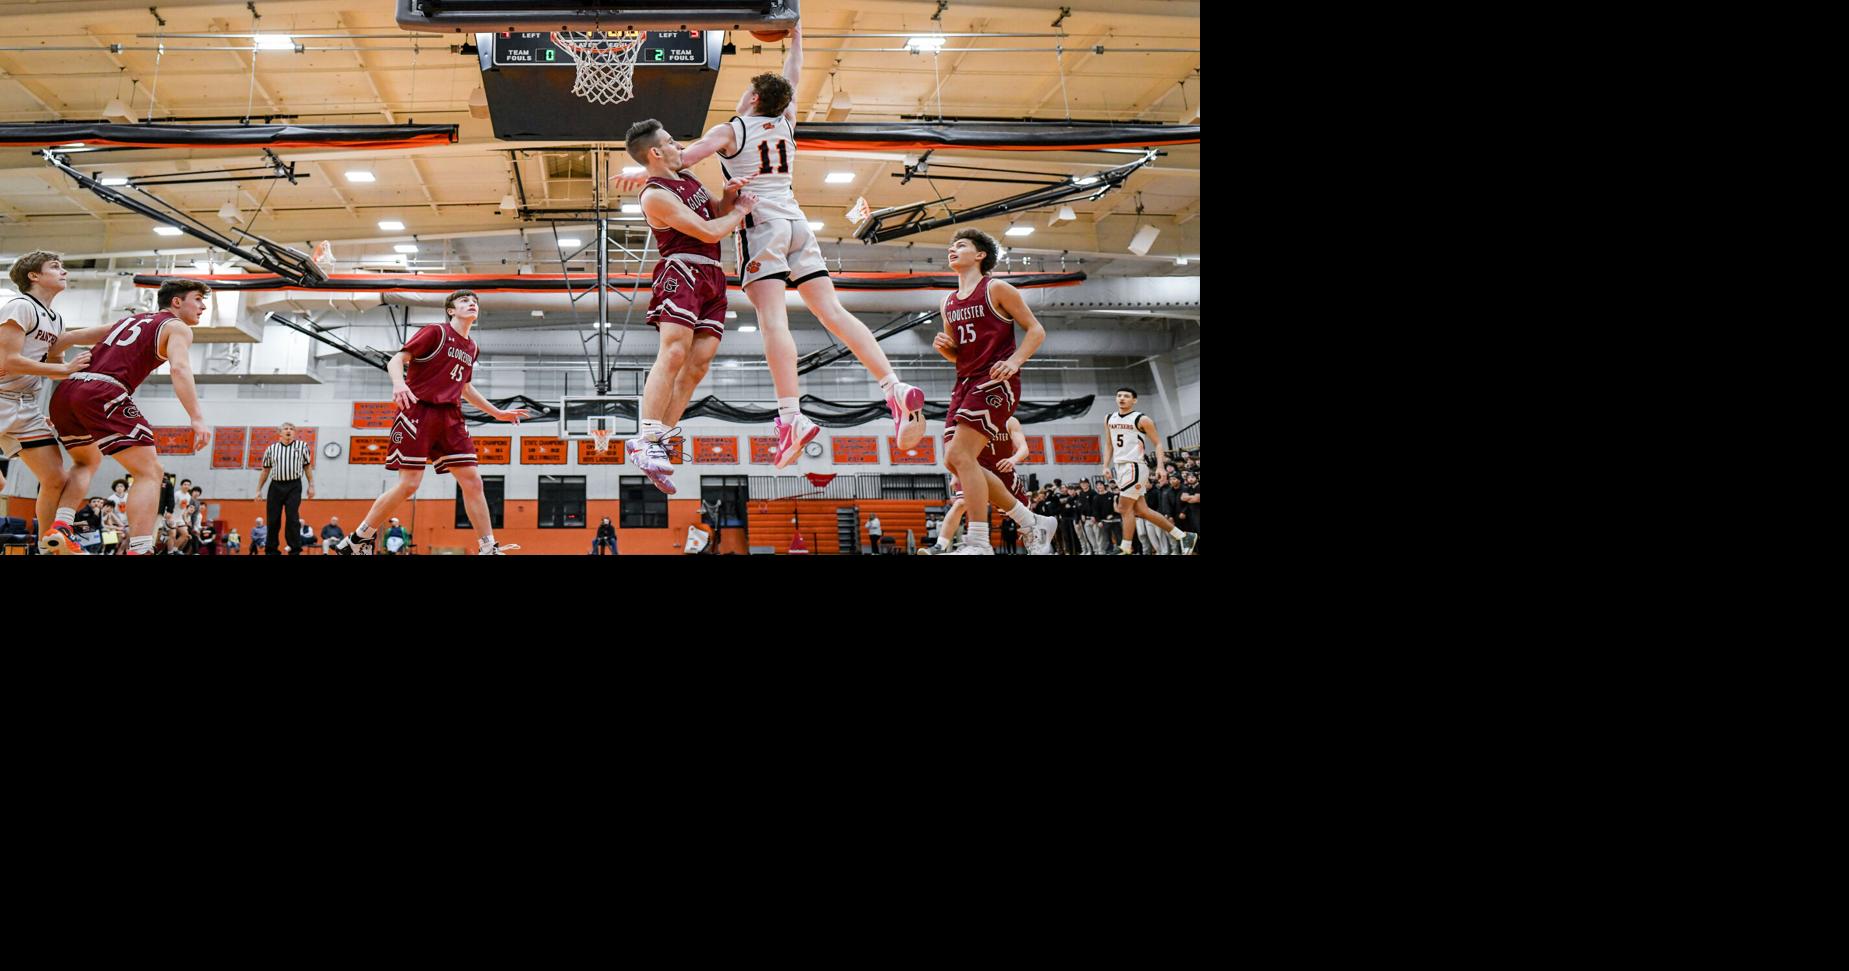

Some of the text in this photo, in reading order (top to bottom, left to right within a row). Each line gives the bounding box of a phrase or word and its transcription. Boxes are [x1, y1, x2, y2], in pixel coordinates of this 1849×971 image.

[655, 49, 664, 61] 2
[757, 138, 789, 175] 11
[103, 316, 154, 347] 15
[957, 323, 977, 345] 25
[449, 363, 465, 382] 45
[1116, 433, 1124, 448] 5
